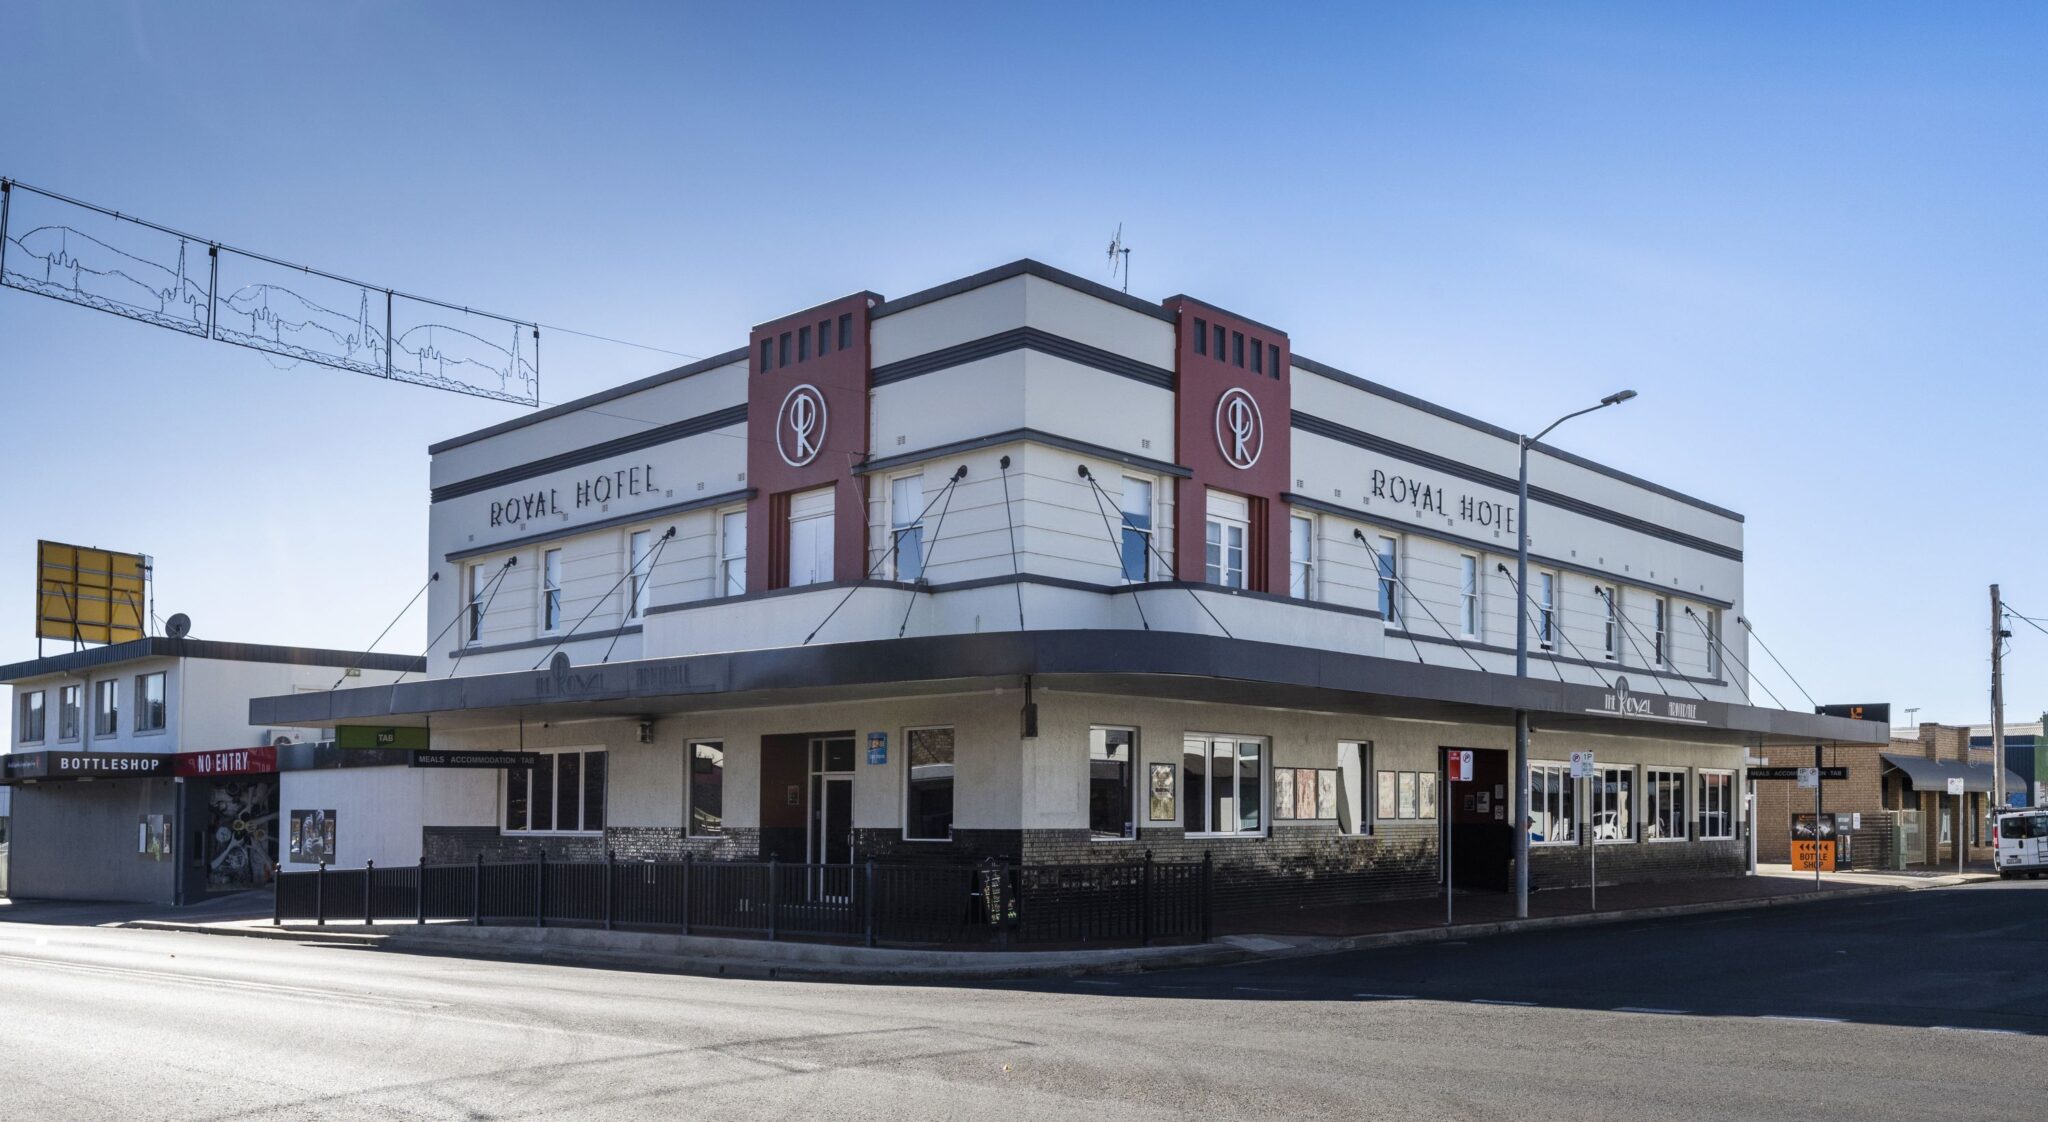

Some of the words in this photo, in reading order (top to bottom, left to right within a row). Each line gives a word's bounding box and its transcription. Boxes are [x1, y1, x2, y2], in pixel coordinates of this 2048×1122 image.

[490, 488, 563, 528] ROYAL
[576, 463, 659, 508] HOTEL
[1371, 469, 1449, 517] ROYAL
[1460, 494, 1530, 537] HOTE
[1604, 693, 1616, 711] THE
[378, 733, 394, 742] TAB
[60, 757, 160, 771] BOTTLESHOP
[197, 754, 211, 773] NO
[215, 751, 249, 771] ENTRY
[418, 755, 445, 764] MEALS
[450, 755, 516, 765] ACCOMMODATION
[521, 756, 535, 765] TAB
